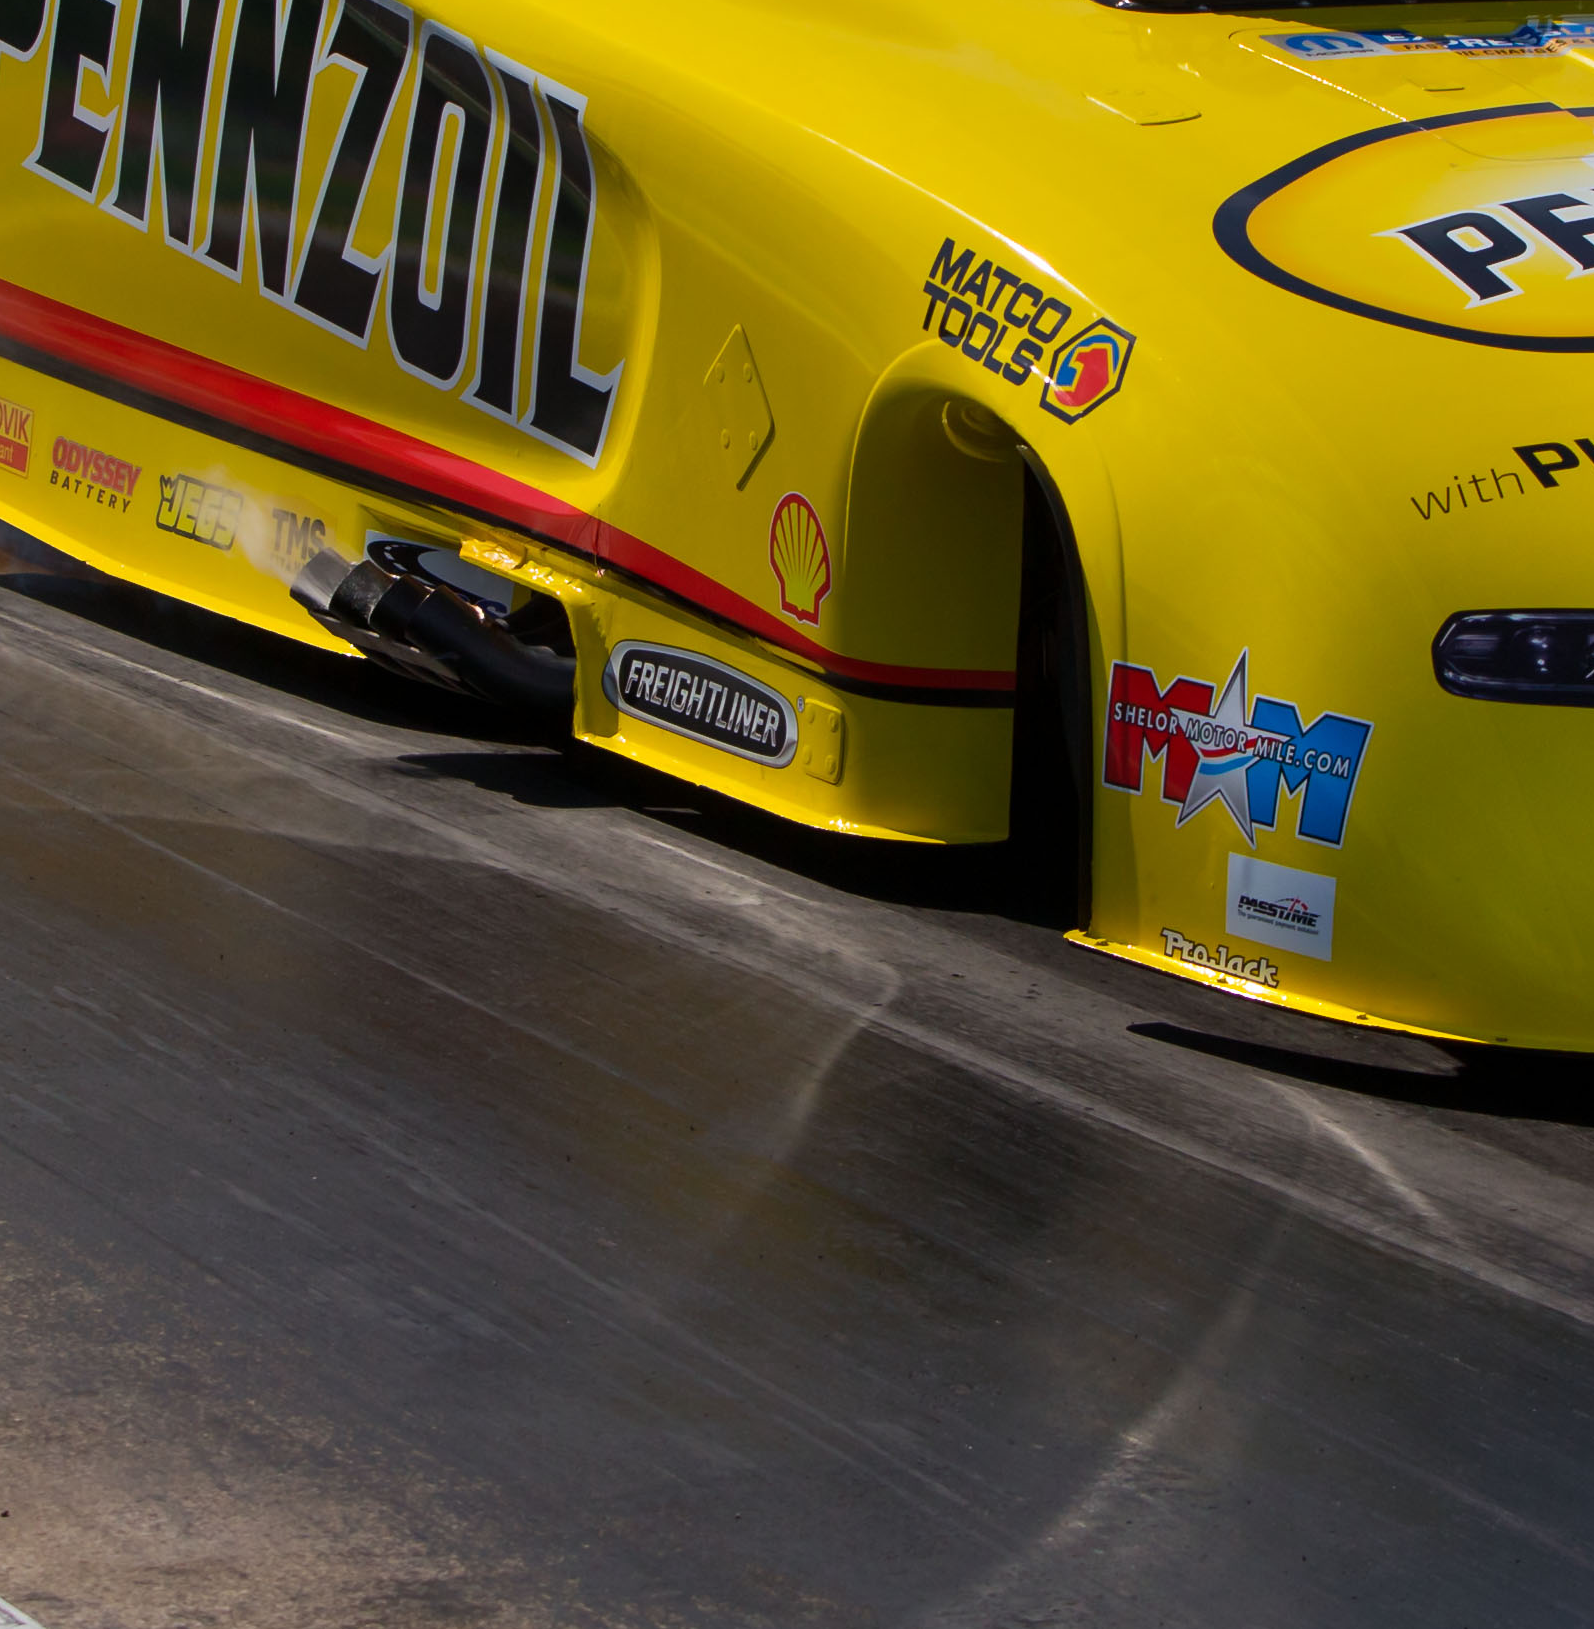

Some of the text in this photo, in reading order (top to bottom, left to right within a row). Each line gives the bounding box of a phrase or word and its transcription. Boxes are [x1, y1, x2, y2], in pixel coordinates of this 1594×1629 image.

[1403, 43, 1440, 51] FAS
[929, 237, 1072, 344] MATCO
[922, 280, 1044, 387] TOOLS
[50, 470, 132, 513] BATTERY
[52, 435, 142, 497] ODYSSEY
[1410, 467, 1525, 521] with
[156, 473, 244, 551] JEGS
[272, 507, 327, 558] TMS
[624, 659, 781, 748] FREIGHTLINER
[1113, 701, 1351, 779] SHELOR MOTOR MILE.COM
[1237, 895, 1321, 927] PASSTIME
